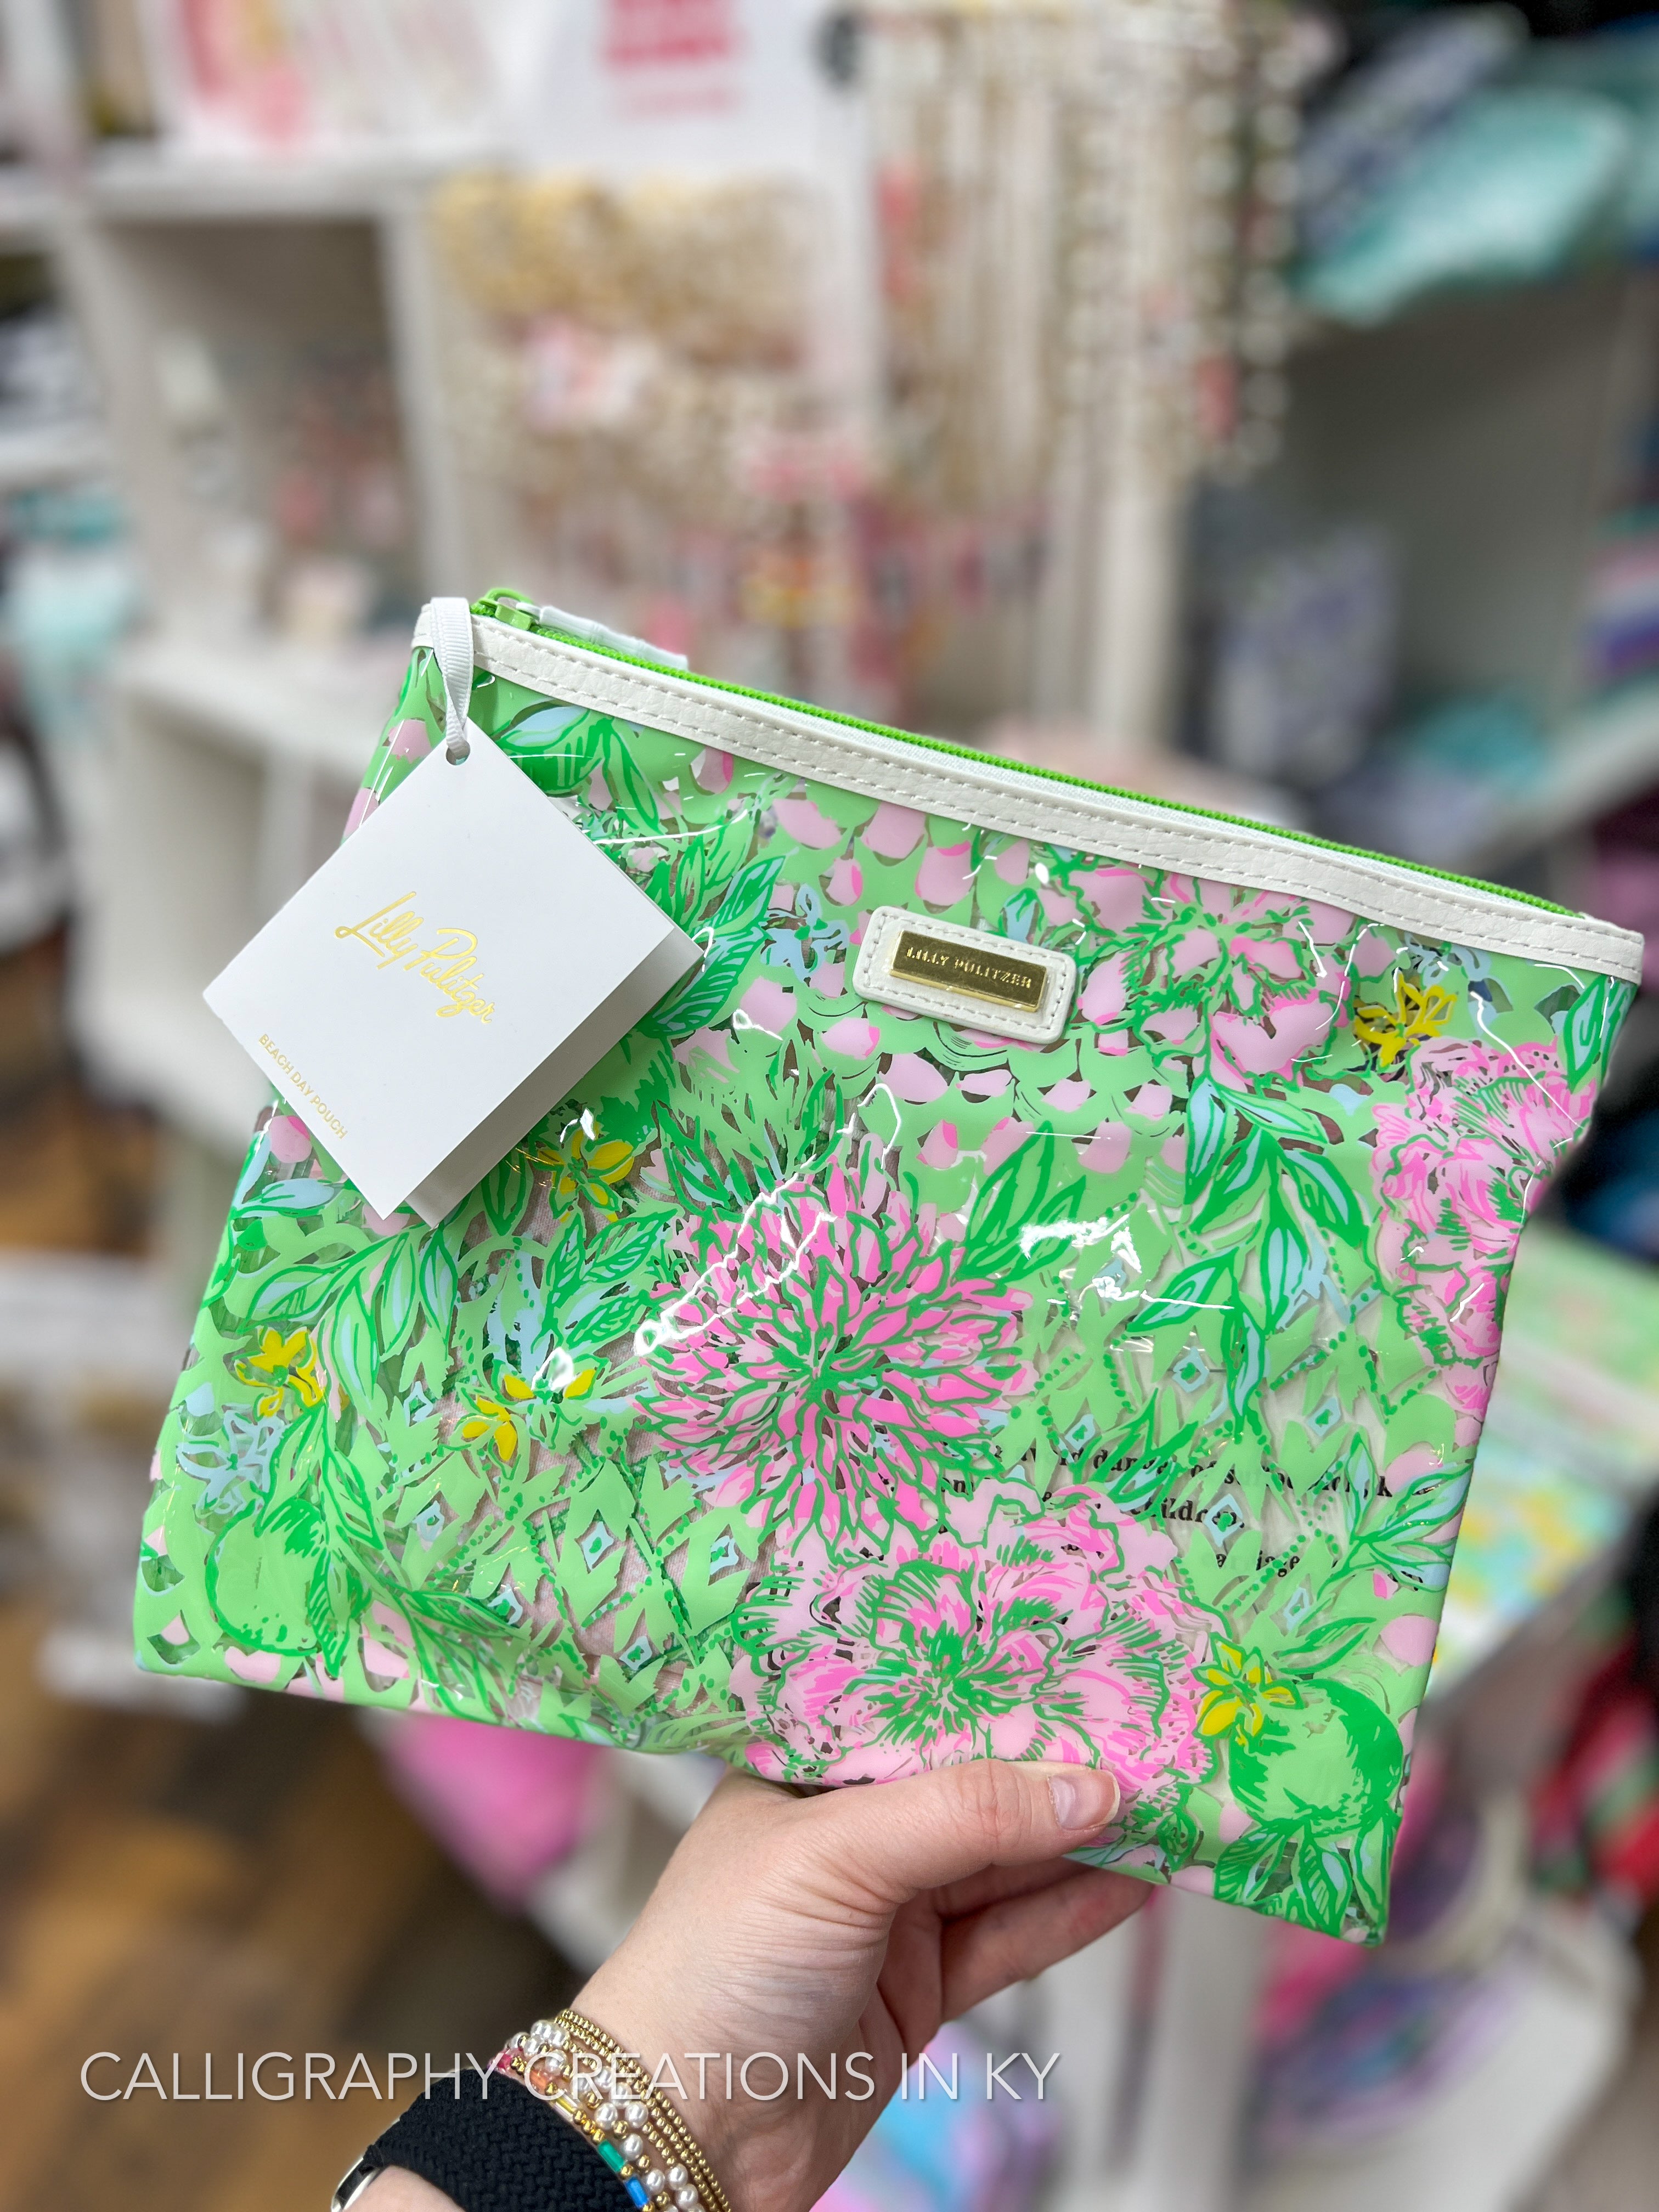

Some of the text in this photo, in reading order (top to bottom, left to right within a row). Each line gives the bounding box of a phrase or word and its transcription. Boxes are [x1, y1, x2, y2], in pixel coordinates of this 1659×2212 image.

[335, 891, 495, 1024] Lilly Pulitzer
[906, 947, 1032, 989] LILLY PULITZER
[259, 1034, 348, 1139] BEACH DAY POUCH
